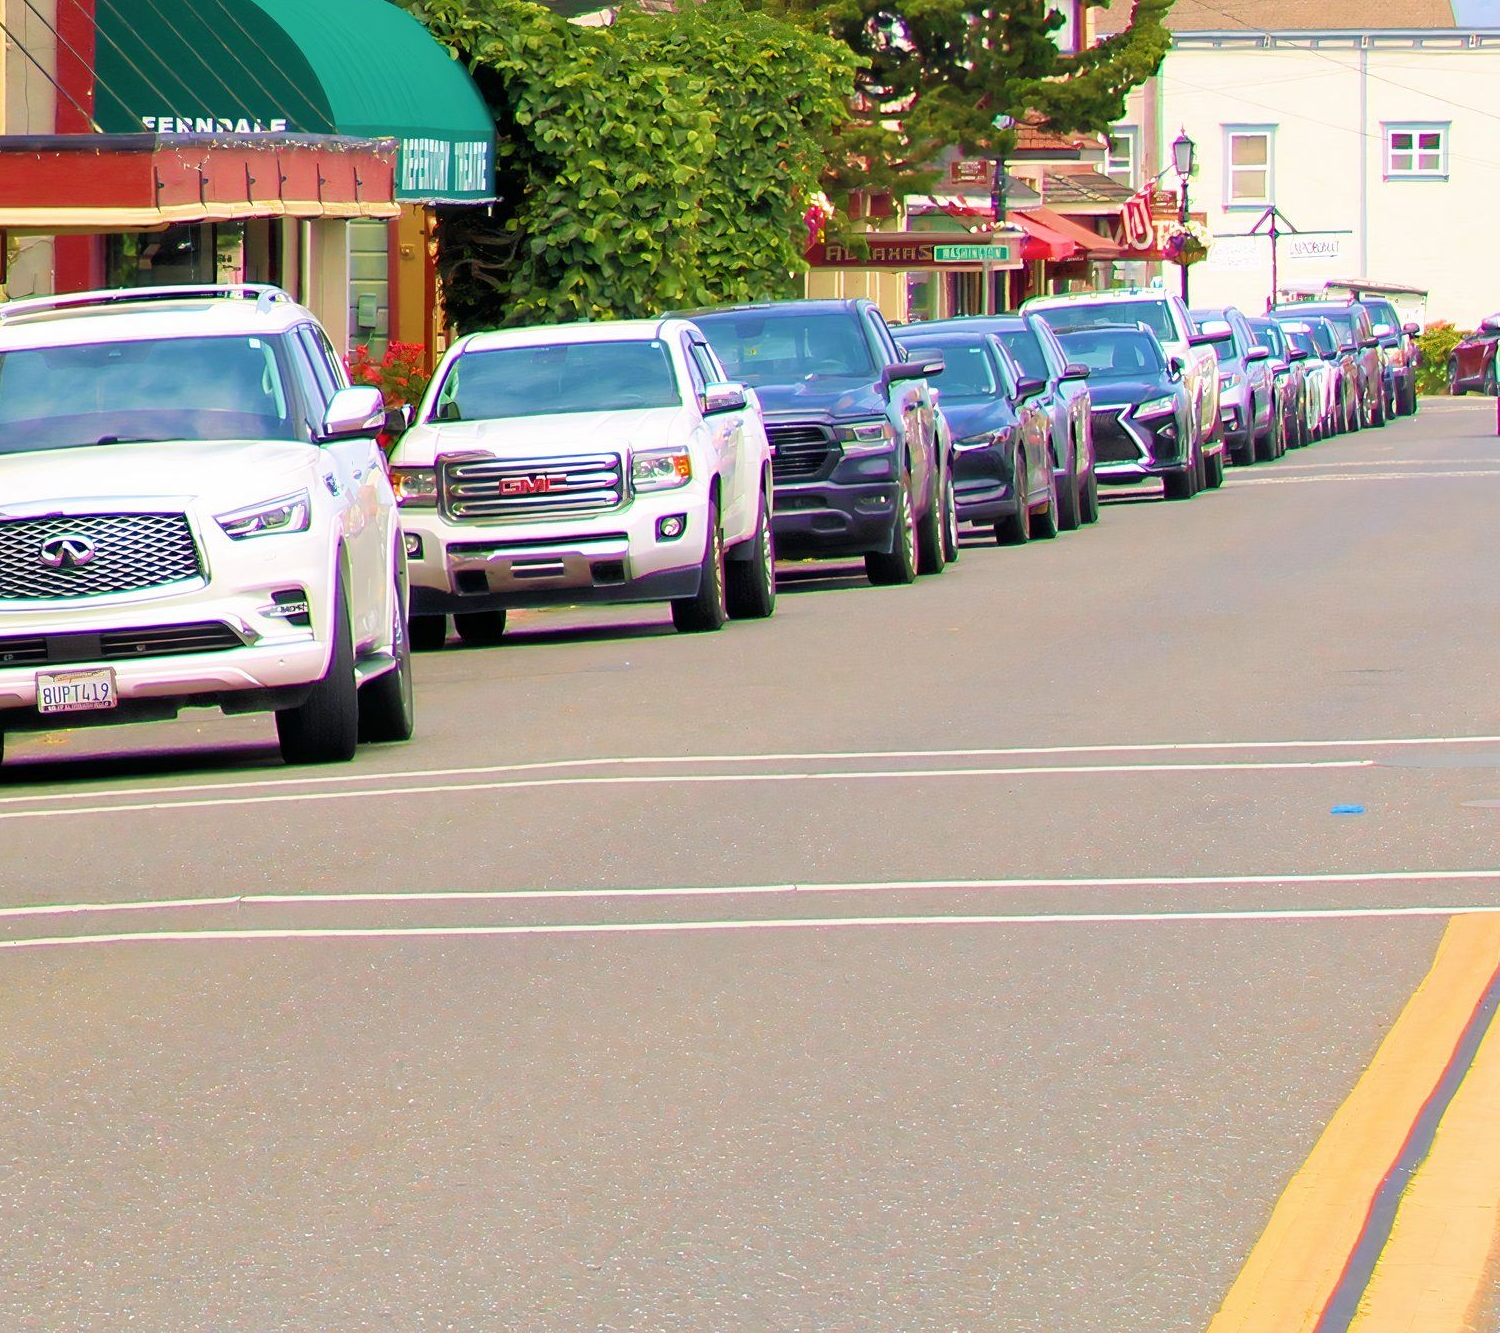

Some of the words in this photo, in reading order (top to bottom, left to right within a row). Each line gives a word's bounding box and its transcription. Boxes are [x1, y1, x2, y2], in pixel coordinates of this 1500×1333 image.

[141, 116, 287, 133] FERNDALE
[499, 474, 567, 496] GMC
[43, 682, 109, 705] 8UPT419
